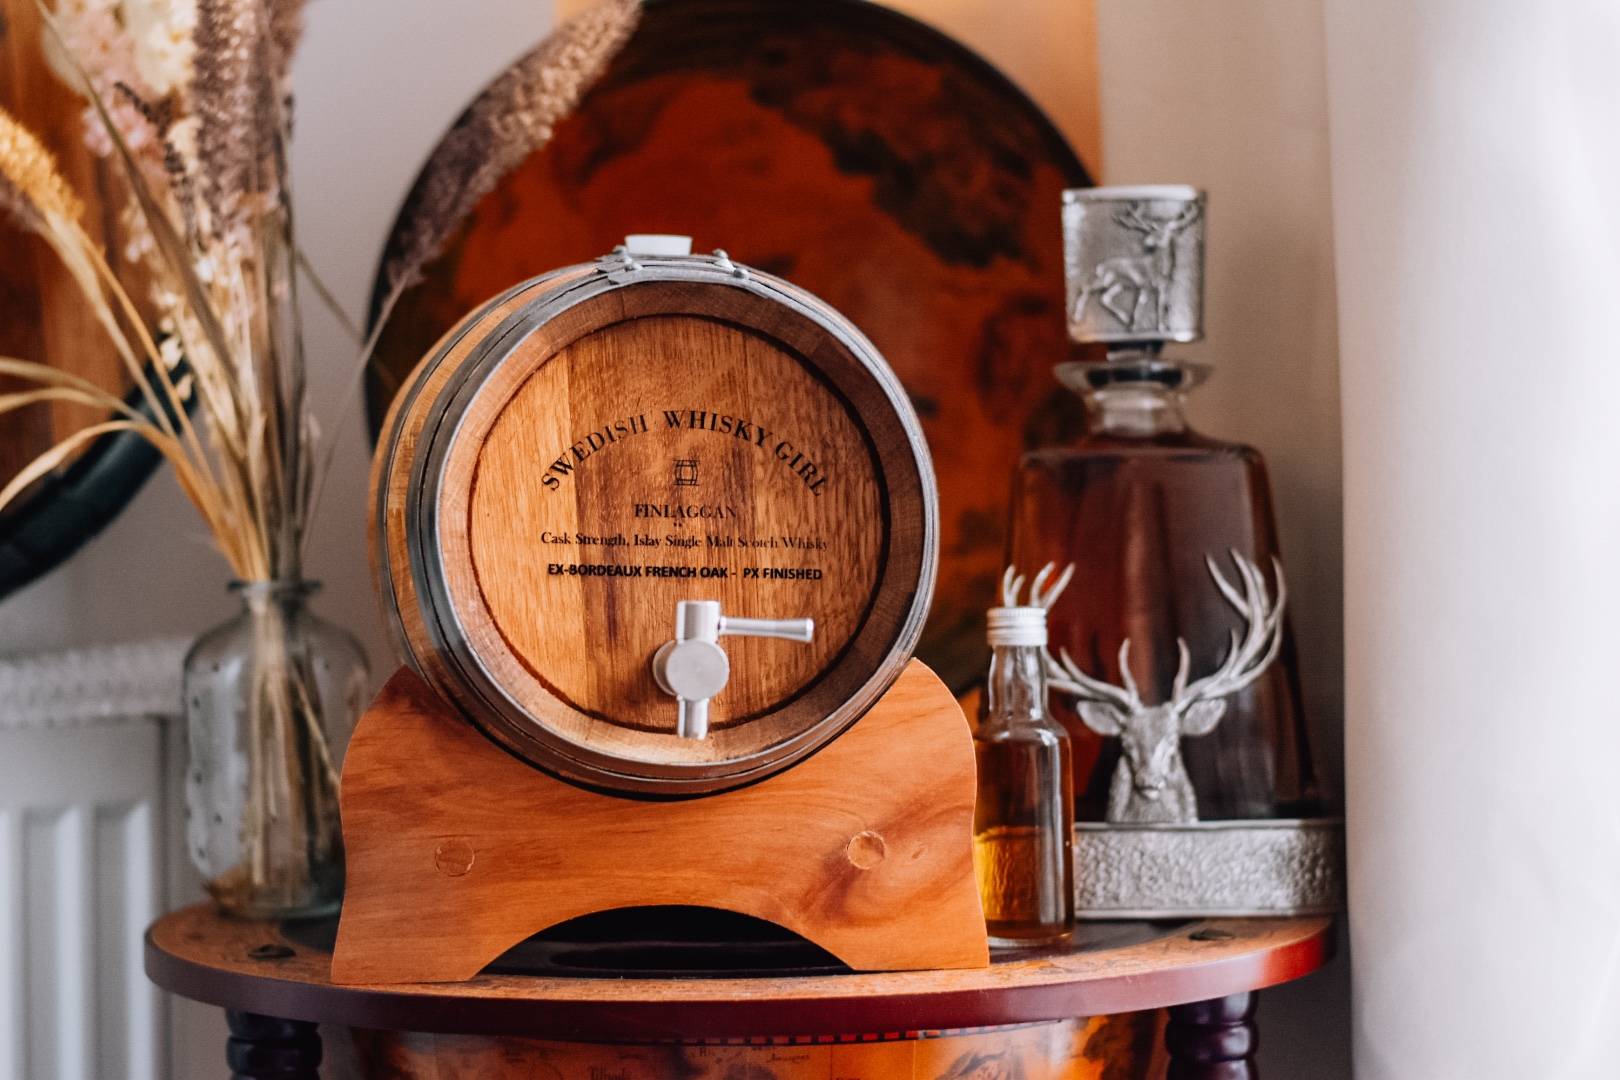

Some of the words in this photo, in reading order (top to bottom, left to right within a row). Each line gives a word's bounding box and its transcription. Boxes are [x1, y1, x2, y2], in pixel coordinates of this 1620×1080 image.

[541, 414, 648, 491] SWEDISH
[663, 410, 773, 448] WHISKY
[775, 441, 828, 497] GIRL
[634, 503, 737, 519] FINLAGGAN
[541, 531, 571, 545] Cask
[634, 534, 662, 548] Islay
[665, 534, 702, 549] Single
[707, 535, 733, 548] Malt
[738, 536, 778, 549] Scotch
[783, 537, 828, 551] Whisky
[547, 563, 642, 577] EX-BORDEAUX
[645, 565, 697, 578] FRENCH
[700, 566, 728, 578] OAK
[743, 567, 760, 579] PX
[763, 568, 823, 580] FINISHED
